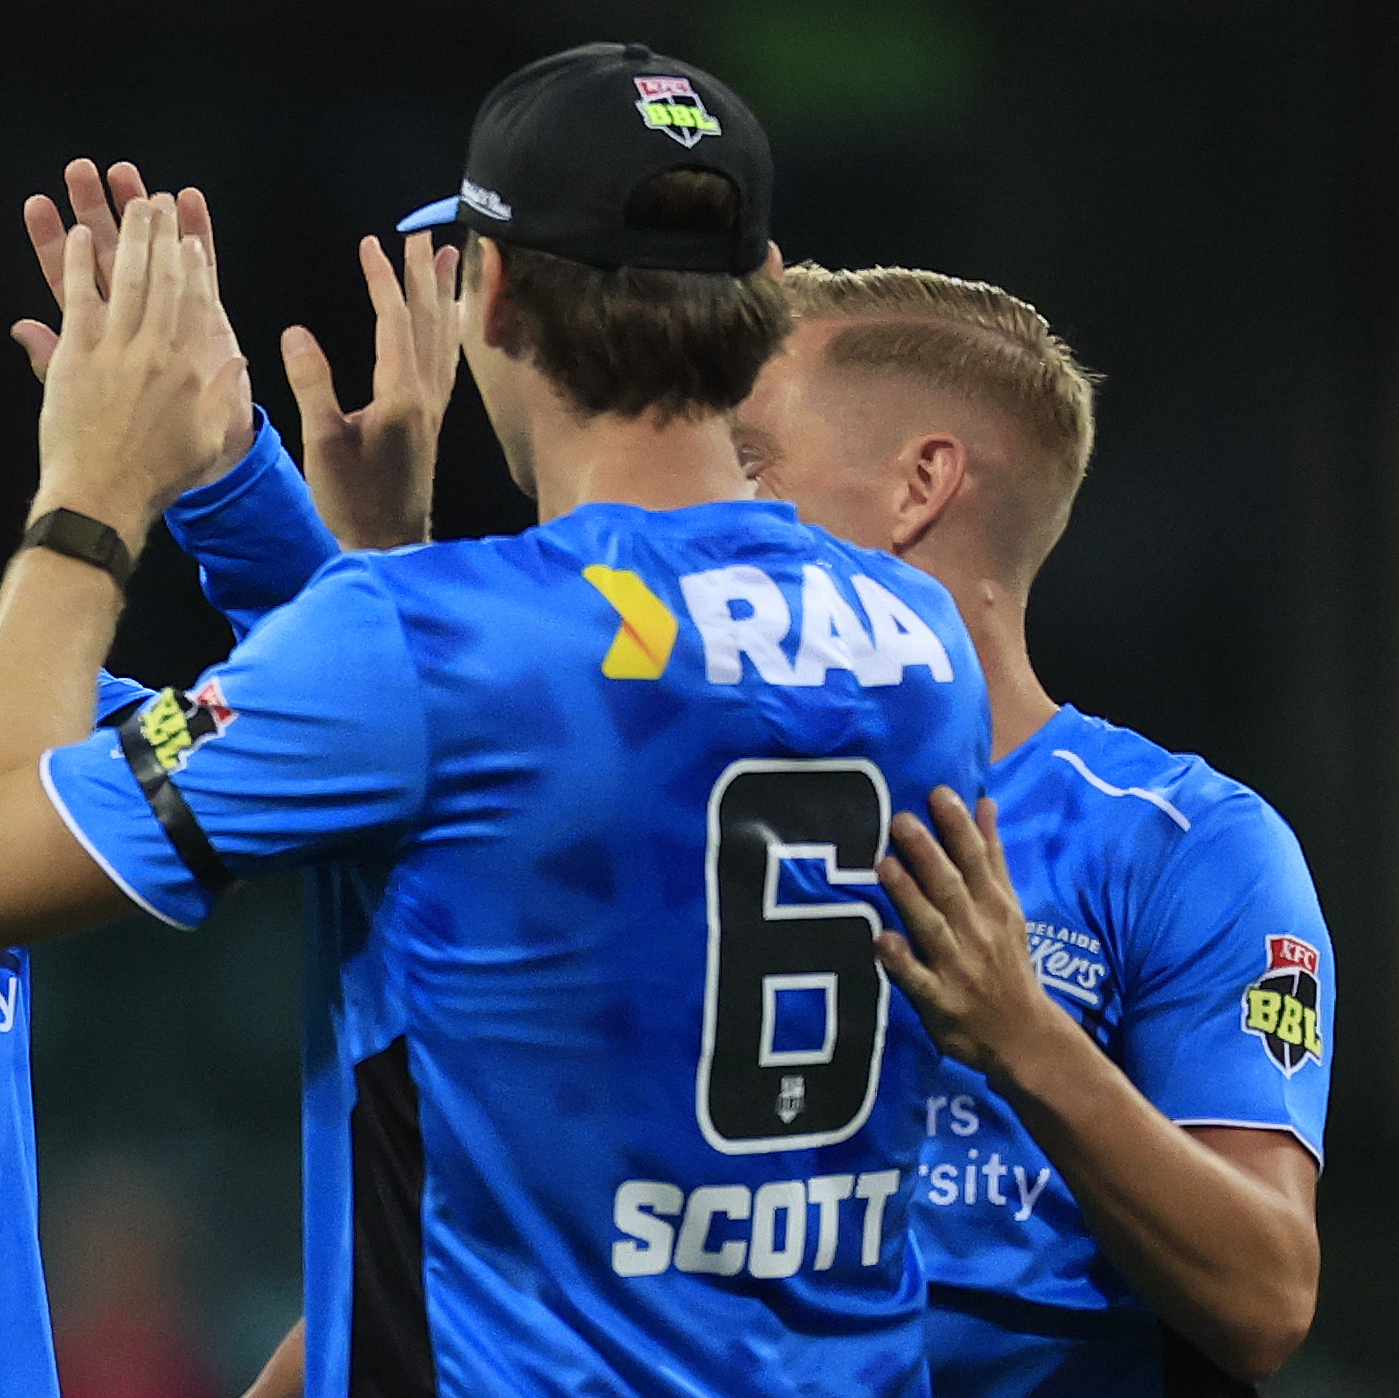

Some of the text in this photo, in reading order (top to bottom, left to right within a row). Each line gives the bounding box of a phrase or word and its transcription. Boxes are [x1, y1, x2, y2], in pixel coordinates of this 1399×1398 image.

[645, 103, 718, 131] BBL
[680, 564, 954, 687] RAA
[697, 757, 892, 1155] 6
[1279, 940, 1314, 970] KFC
[1248, 989, 1321, 1056] BBL
[611, 1169, 901, 1279] SCOTT
